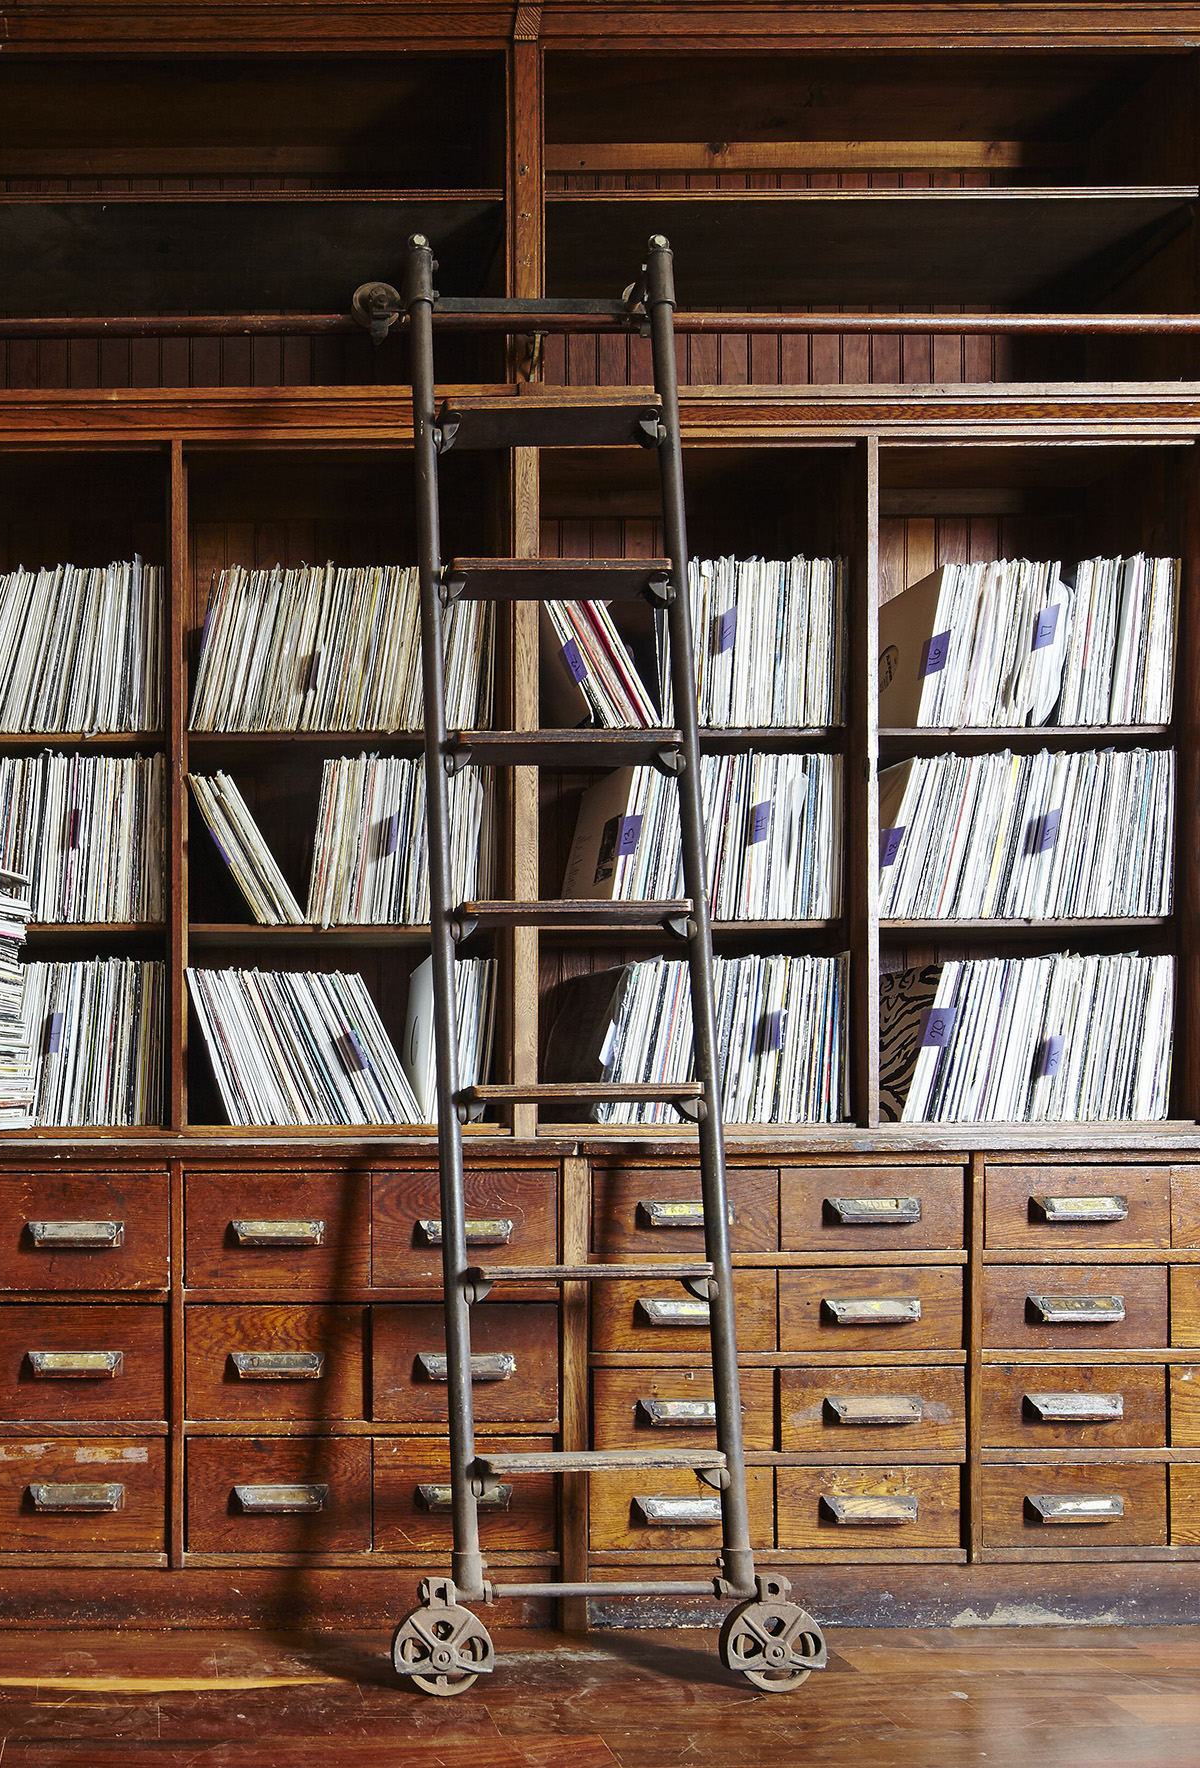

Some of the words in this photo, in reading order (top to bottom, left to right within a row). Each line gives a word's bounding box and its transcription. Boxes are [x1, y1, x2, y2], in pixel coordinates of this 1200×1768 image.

[1039, 624, 1053, 638] 17
[928, 647, 942, 667] 16
[754, 815, 768, 833] 14
[622, 826, 634, 845] 13
[929, 1018, 947, 1040] 20
